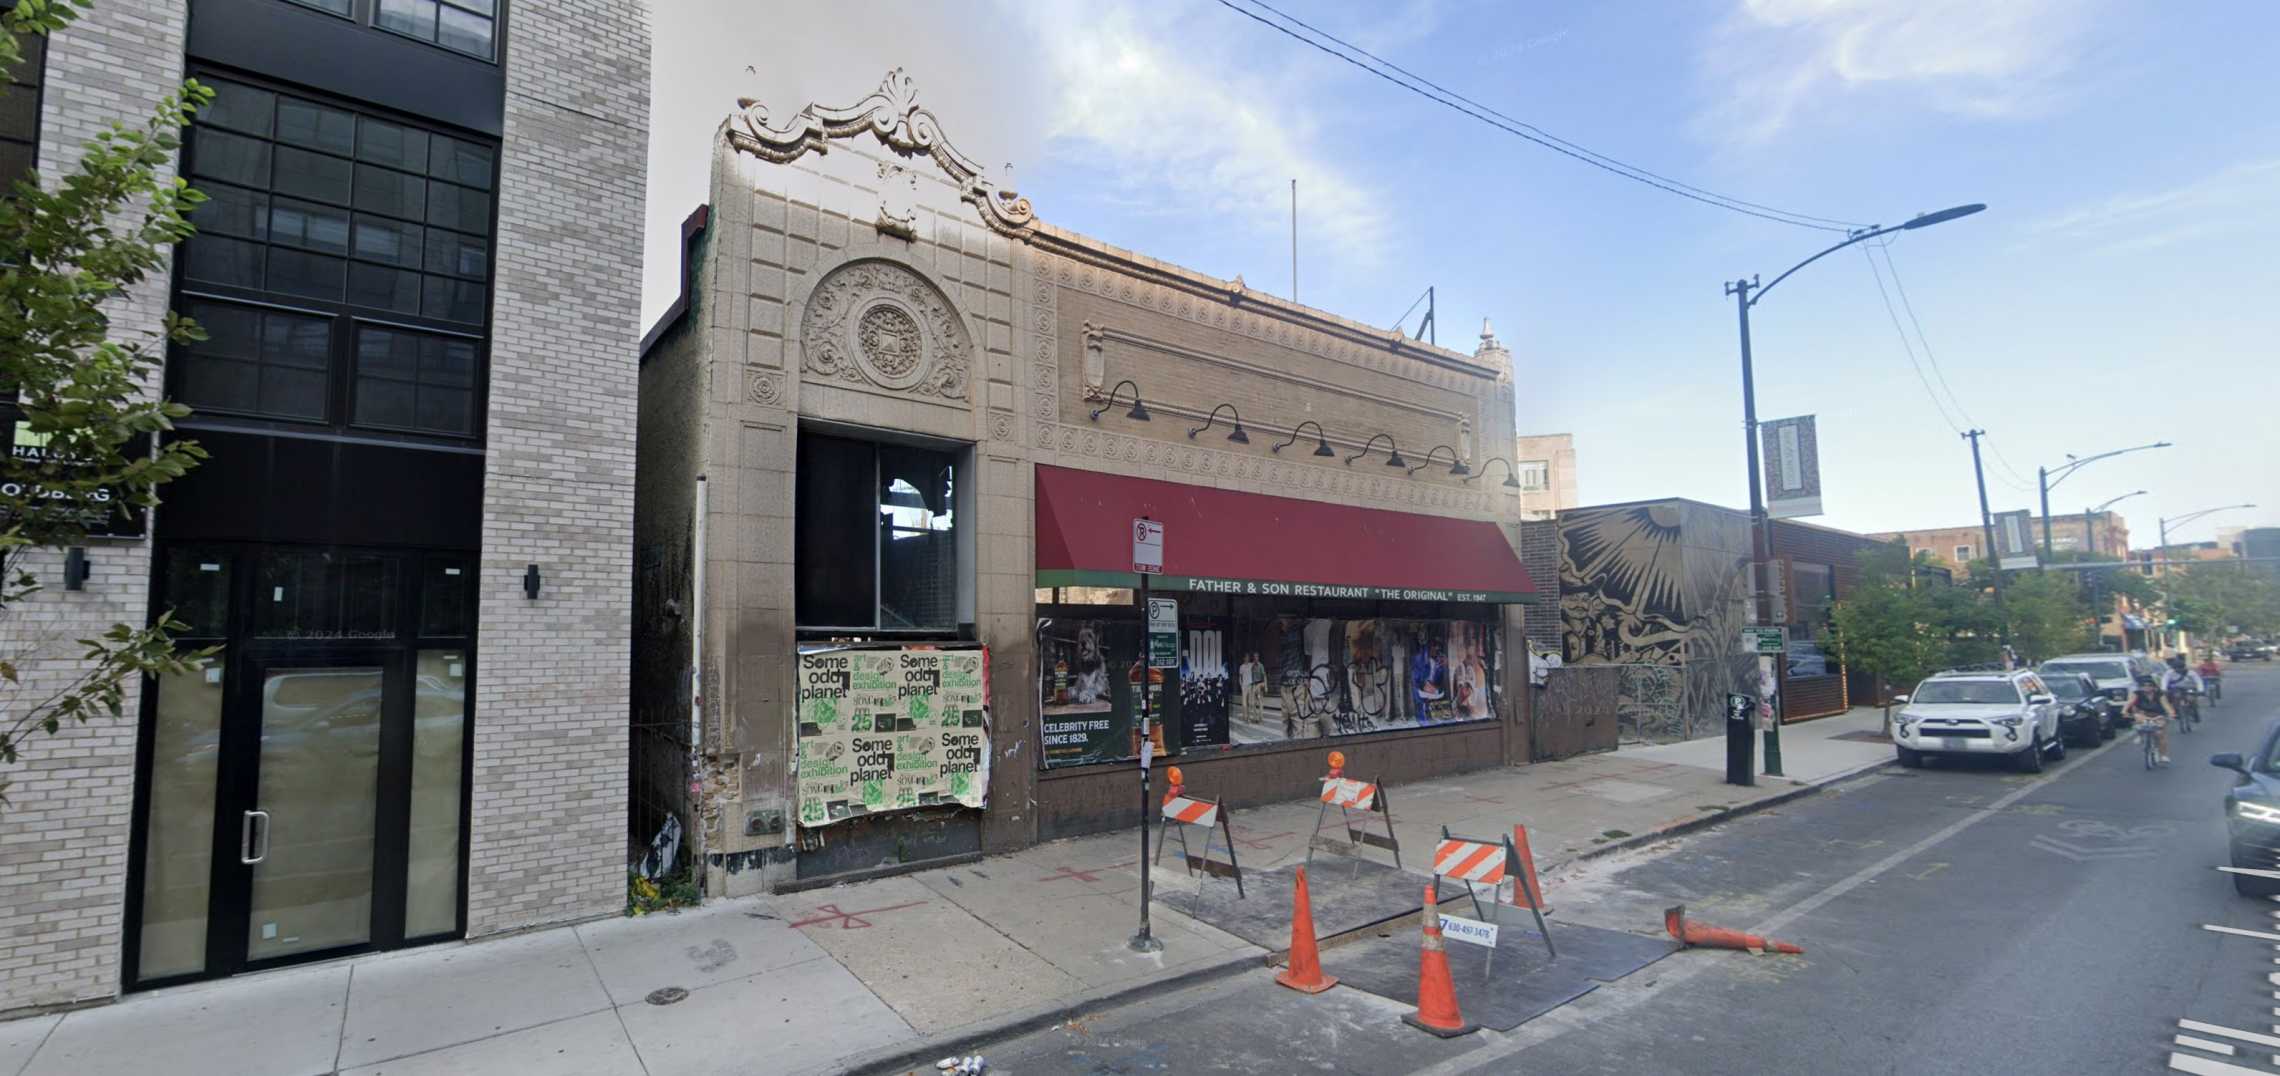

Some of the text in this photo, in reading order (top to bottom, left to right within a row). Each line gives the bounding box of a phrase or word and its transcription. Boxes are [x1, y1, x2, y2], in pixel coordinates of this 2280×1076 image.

[1188, 578, 1241, 593] FATHER
[1247, 581, 1257, 594] &
[1262, 583, 1289, 595] SON
[1294, 584, 1369, 598] RESTAURANT
[803, 655, 848, 669] Some
[900, 654, 938, 668] Some
[809, 669, 842, 684] odd
[905, 667, 932, 682] odd
[853, 680, 896, 689] exhibition
[898, 683, 938, 700] planet
[802, 685, 848, 703] planet
[1044, 720, 1110, 733] CELEBRITY FREE
[852, 737, 893, 753] Some
[942, 732, 979, 747] Some
[1044, 734, 1068, 745] SINCE
[857, 751, 886, 767] odd
[946, 745, 972, 760] odd
[801, 766, 848, 778] exhibition
[850, 767, 892, 786] planet
[940, 760, 978, 778] planet
